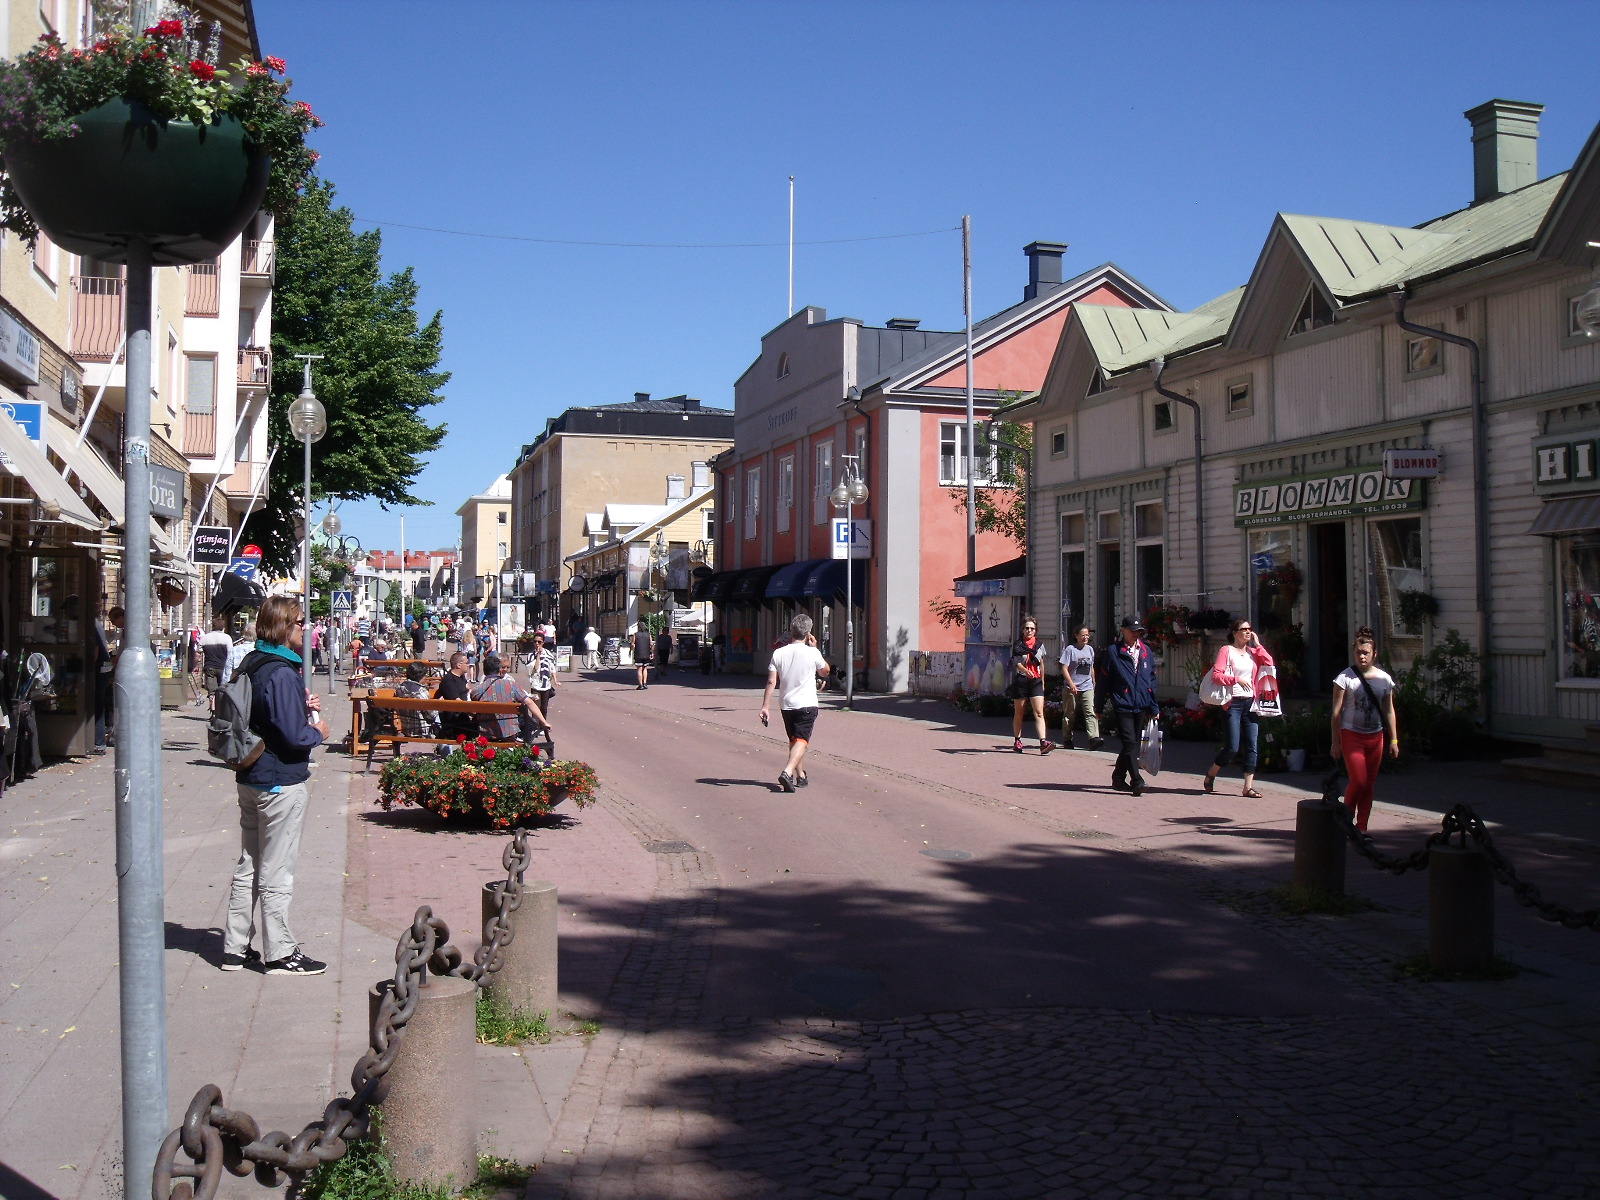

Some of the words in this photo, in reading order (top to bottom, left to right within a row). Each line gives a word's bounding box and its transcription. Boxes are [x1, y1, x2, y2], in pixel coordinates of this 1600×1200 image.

[1394, 458, 1438, 469] BLOMMOR
[1238, 475, 1406, 513] BLOMMOR
[1244, 516, 1282, 525] BLOMBERGS
[1288, 508, 1352, 520] BLOMSTERHANDEL
[196, 534, 229, 546] Timjan
